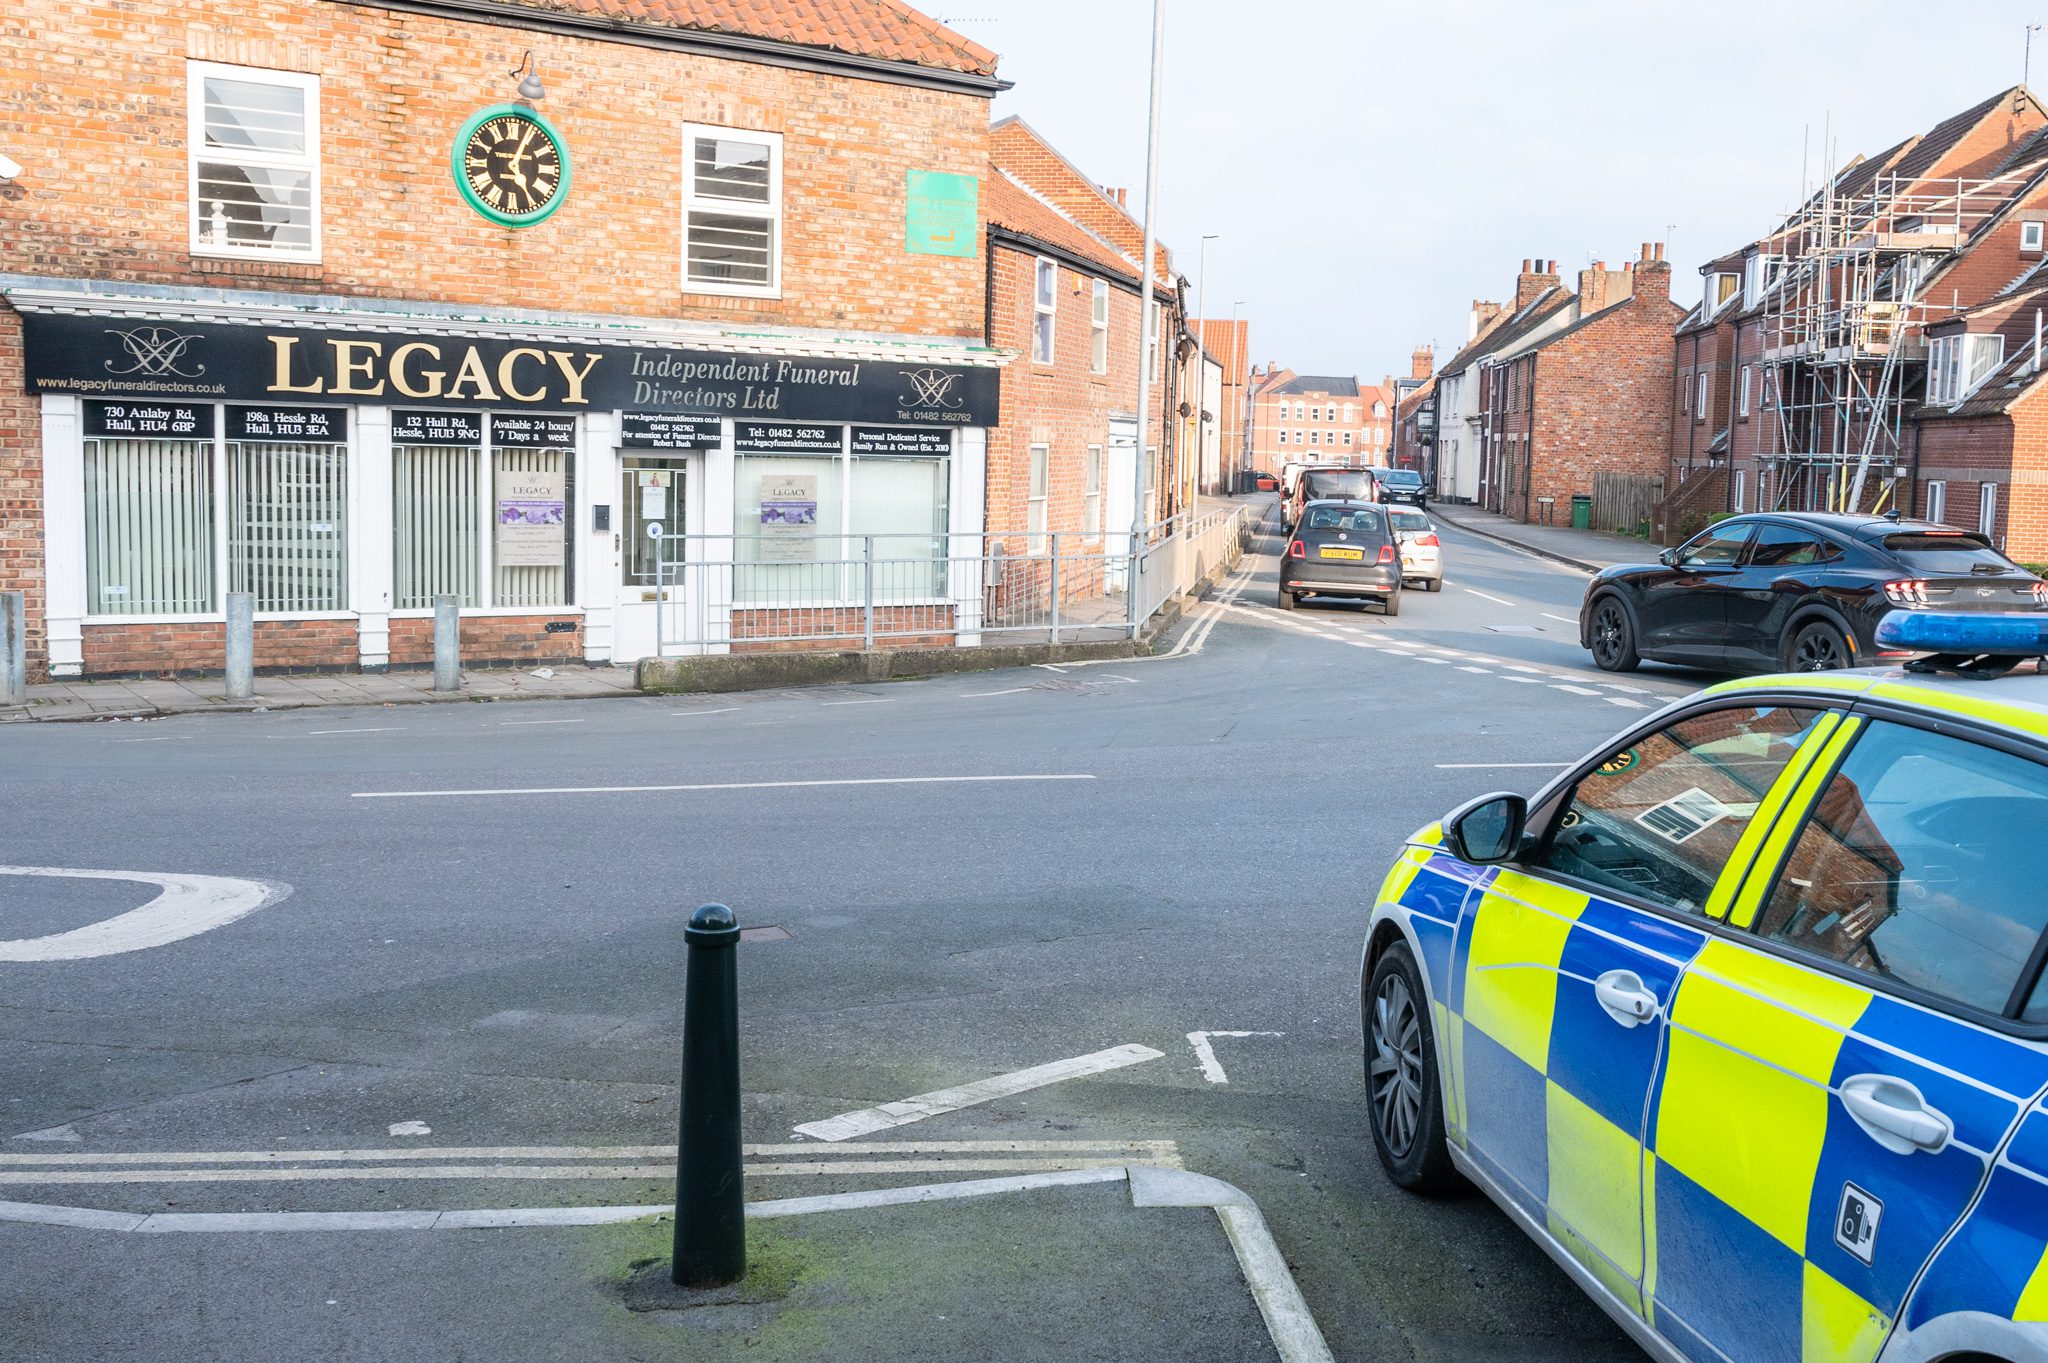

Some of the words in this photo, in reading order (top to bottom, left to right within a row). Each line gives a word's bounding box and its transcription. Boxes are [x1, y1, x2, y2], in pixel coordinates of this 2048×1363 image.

[266, 334, 602, 404] LEGACY
[630, 352, 770, 385] Independent
[776, 360, 860, 386] Funeral
[36, 378, 226, 394] www.legacyfuneraldirectors.co.uk
[634, 381, 736, 408] Directors
[742, 386, 780, 410] Ltd
[104, 406, 124, 417] 730
[129, 408, 171, 420] Anlaby
[175, 409, 196, 421] Rd,
[246, 412, 268, 422] 198a
[274, 412, 306, 424] Hessle
[310, 414, 329, 426] Rd,
[914, 412, 939, 420] 01482
[942, 412, 972, 422] 562762
[106, 420, 136, 432] Hull,
[140, 420, 168, 432] HU4
[172, 422, 196, 432] 6BP
[406, 416, 422, 426] 132
[426, 417, 448, 427] Hull
[451, 418, 468, 429] Rd,
[492, 419, 532, 430] Available
[534, 420, 546, 430] 24
[548, 420, 574, 432] hours/
[246, 424, 274, 436] Hull,
[276, 424, 302, 434] HU3
[306, 425, 329, 436] 3EA
[392, 427, 426, 439] Hessle,
[428, 428, 454, 438] HU13
[458, 429, 480, 439] 9NG
[498, 430, 504, 440] 7
[508, 430, 530, 442] Days
[548, 432, 570, 442] week
[748, 428, 765, 437] Tel:
[768, 428, 793, 438] 01482
[796, 429, 826, 438] 562762
[736, 438, 842, 448] www.legacyfuneraldirectors.co.uk
[852, 442, 873, 451] Family
[920, 443, 933, 451] (Est.
